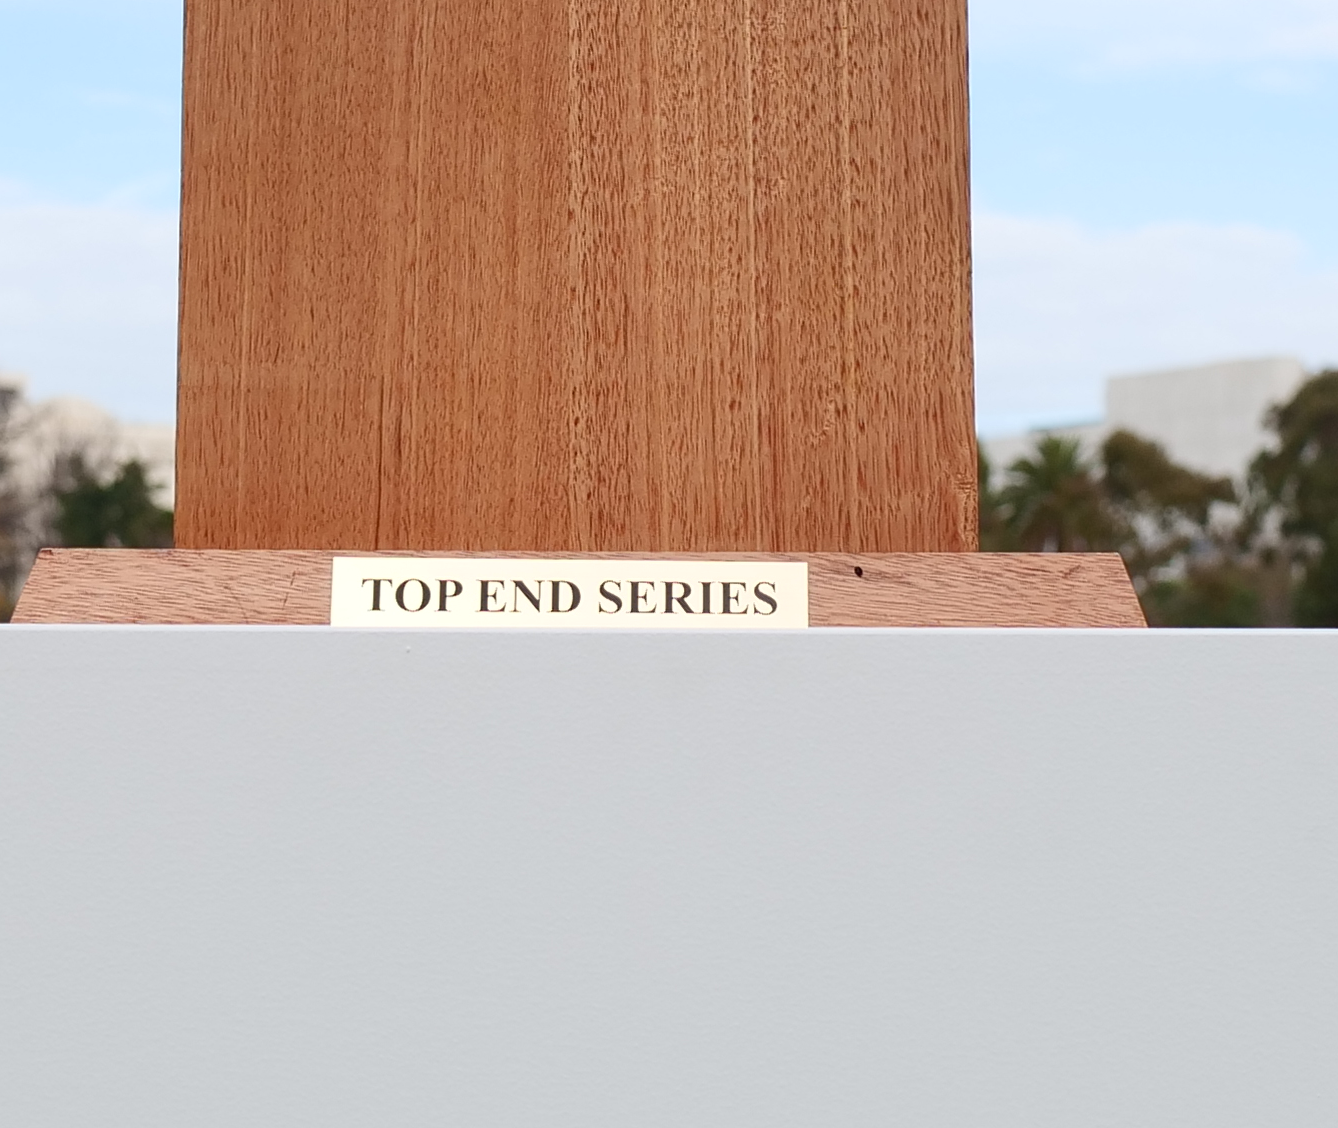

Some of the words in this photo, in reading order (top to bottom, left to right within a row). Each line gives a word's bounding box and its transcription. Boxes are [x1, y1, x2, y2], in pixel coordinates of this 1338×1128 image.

[362, 578, 463, 612] TOP
[476, 578, 581, 613] END
[598, 580, 778, 616] SERIES
